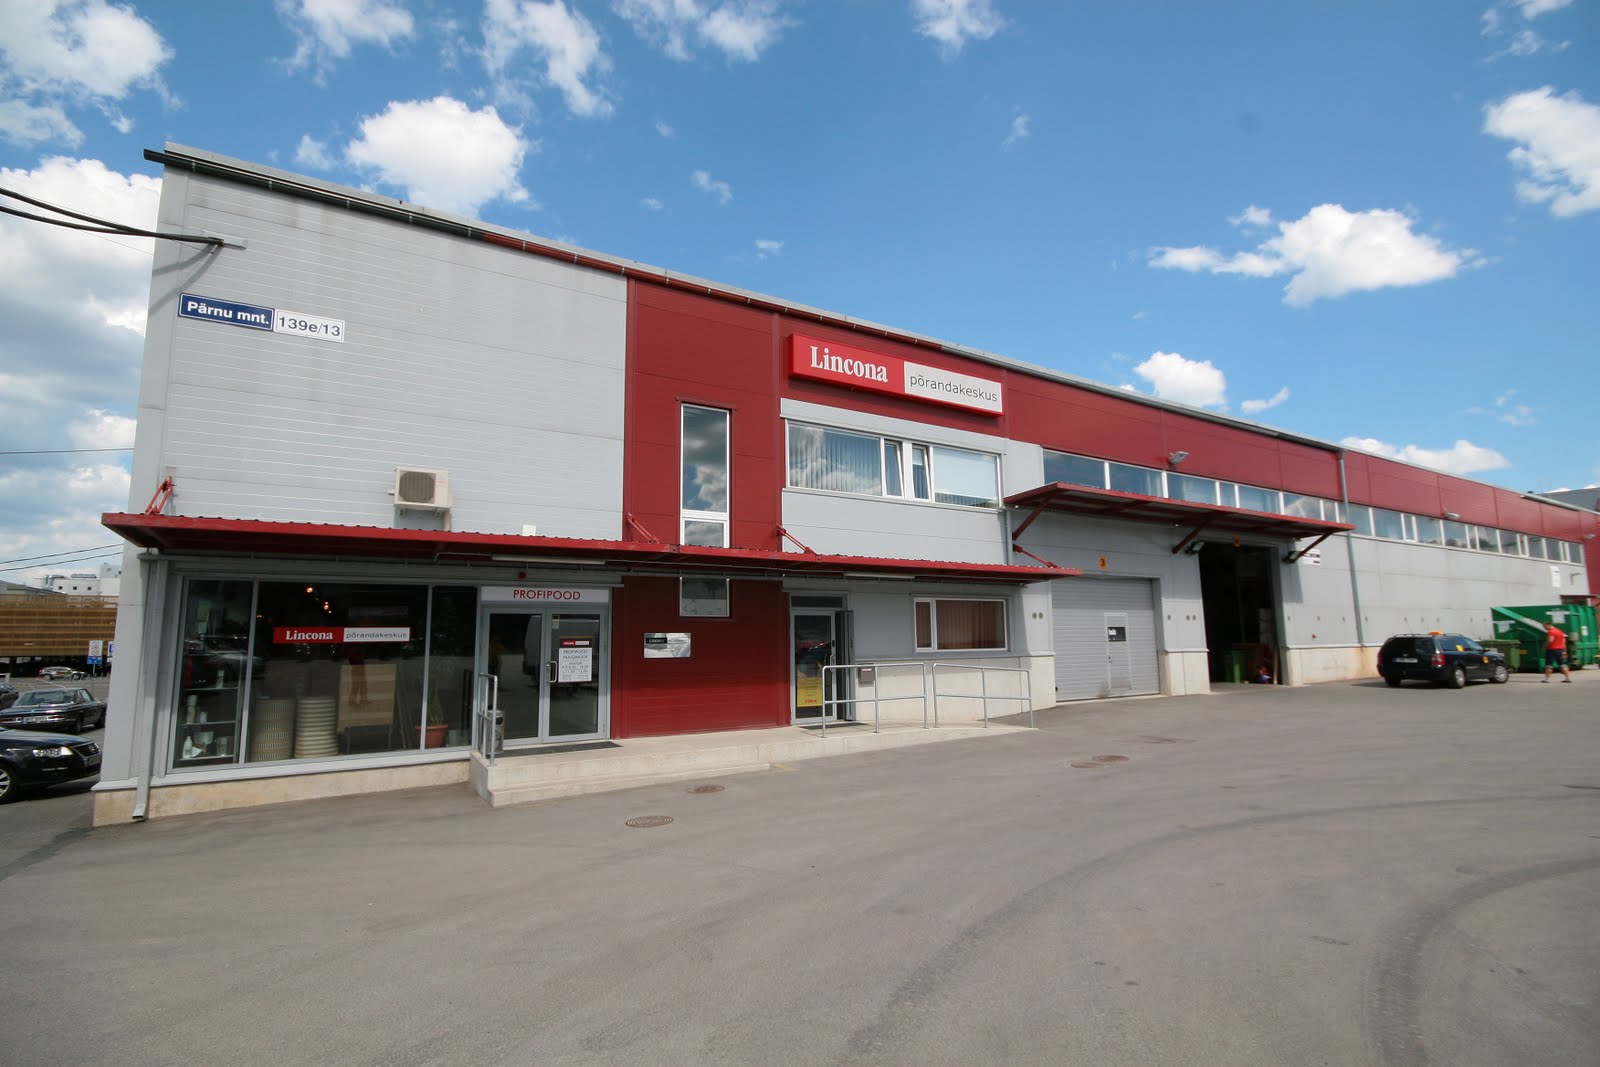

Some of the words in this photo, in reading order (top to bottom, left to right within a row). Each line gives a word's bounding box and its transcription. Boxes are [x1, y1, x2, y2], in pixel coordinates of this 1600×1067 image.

[187, 301, 232, 319] Pärnu
[237, 310, 269, 325] mnt.
[279, 316, 341, 337] 139e/13
[810, 346, 888, 383] Lincona
[910, 374, 998, 402] põrandakeskus
[513, 589, 581, 600] PROFIPOOD
[285, 630, 333, 640] Lincona
[346, 631, 407, 639] põrandakeskus
